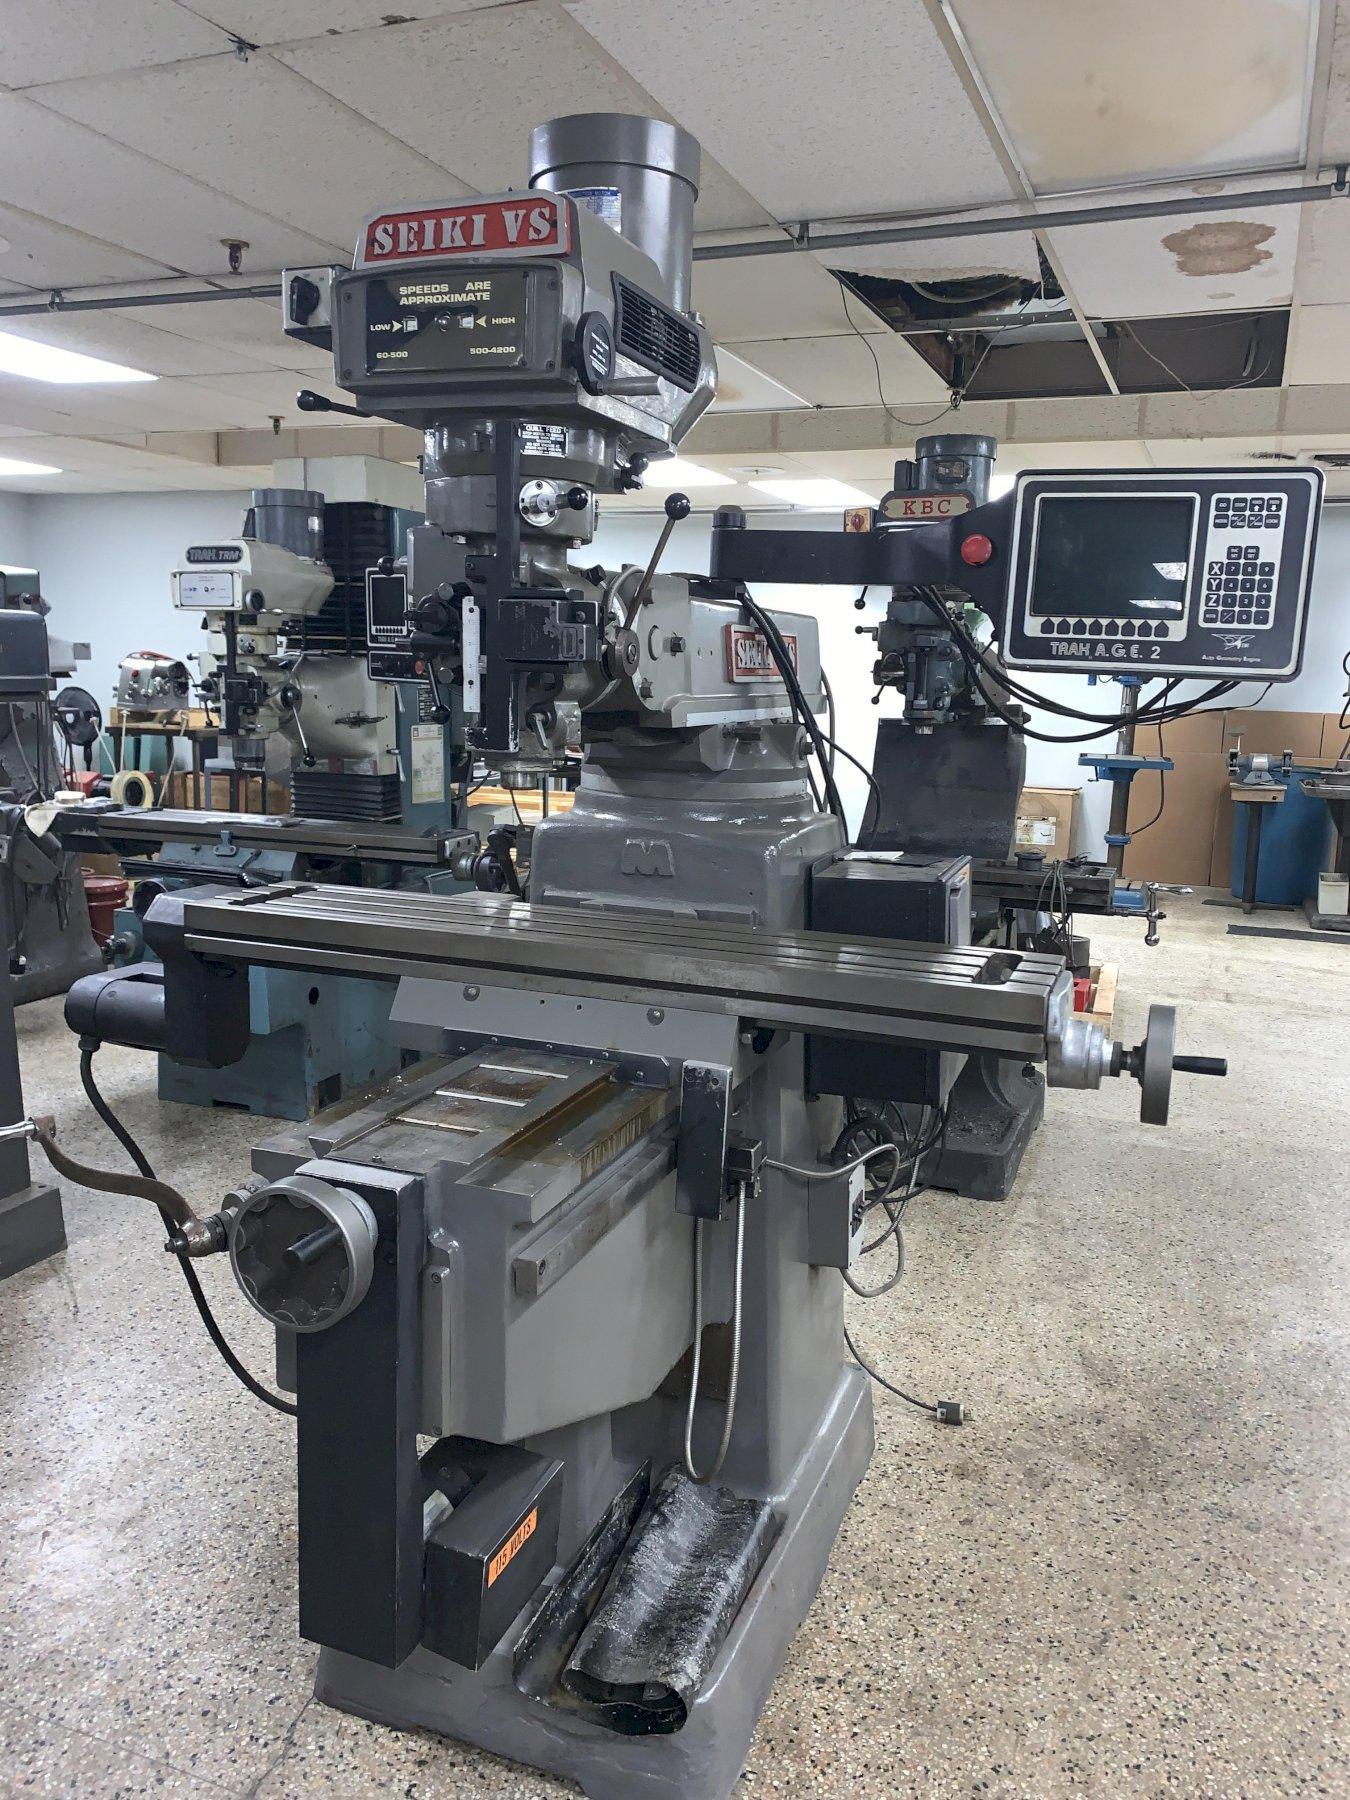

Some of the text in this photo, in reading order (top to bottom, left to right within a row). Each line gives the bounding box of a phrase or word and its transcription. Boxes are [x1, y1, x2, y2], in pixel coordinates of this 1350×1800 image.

[373, 214, 487, 255] SEIKI
[501, 206, 551, 243] VS
[399, 281, 492, 295] SPEEDS ARE
[399, 291, 491, 306] APPROXIMATE
[491, 317, 516, 325] HIGH
[370, 323, 391, 331] LOW
[376, 351, 408, 359] 60-500
[469, 346, 516, 355] 500-4200
[1211, 563, 1221, 575] X
[1210, 579, 1220, 590] Y
[1207, 595, 1218, 606] Z
[1150, 645, 1161, 659] 2
